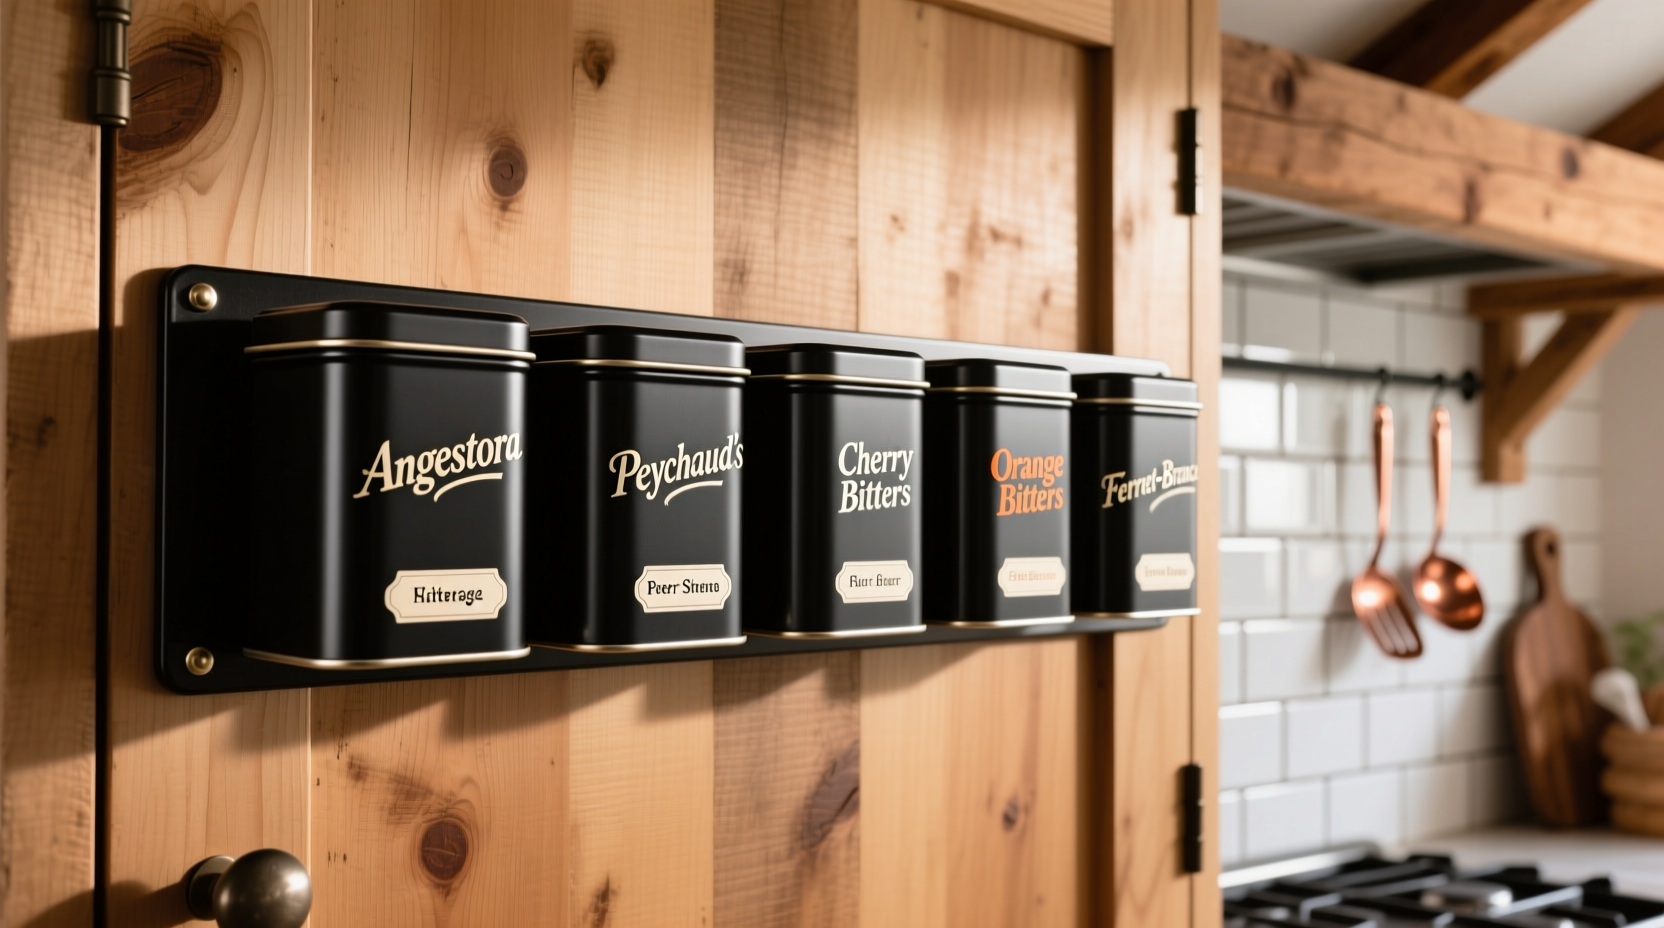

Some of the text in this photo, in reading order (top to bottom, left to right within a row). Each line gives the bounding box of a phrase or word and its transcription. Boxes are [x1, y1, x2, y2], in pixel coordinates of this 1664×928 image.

[353, 432, 523, 499] Angestora
[609, 432, 743, 501] Peychaud's
[838, 441, 914, 481] Cherry
[990, 448, 1064, 487] Orange
[838, 480, 911, 513] Bitters
[996, 484, 1064, 516] Bitters
